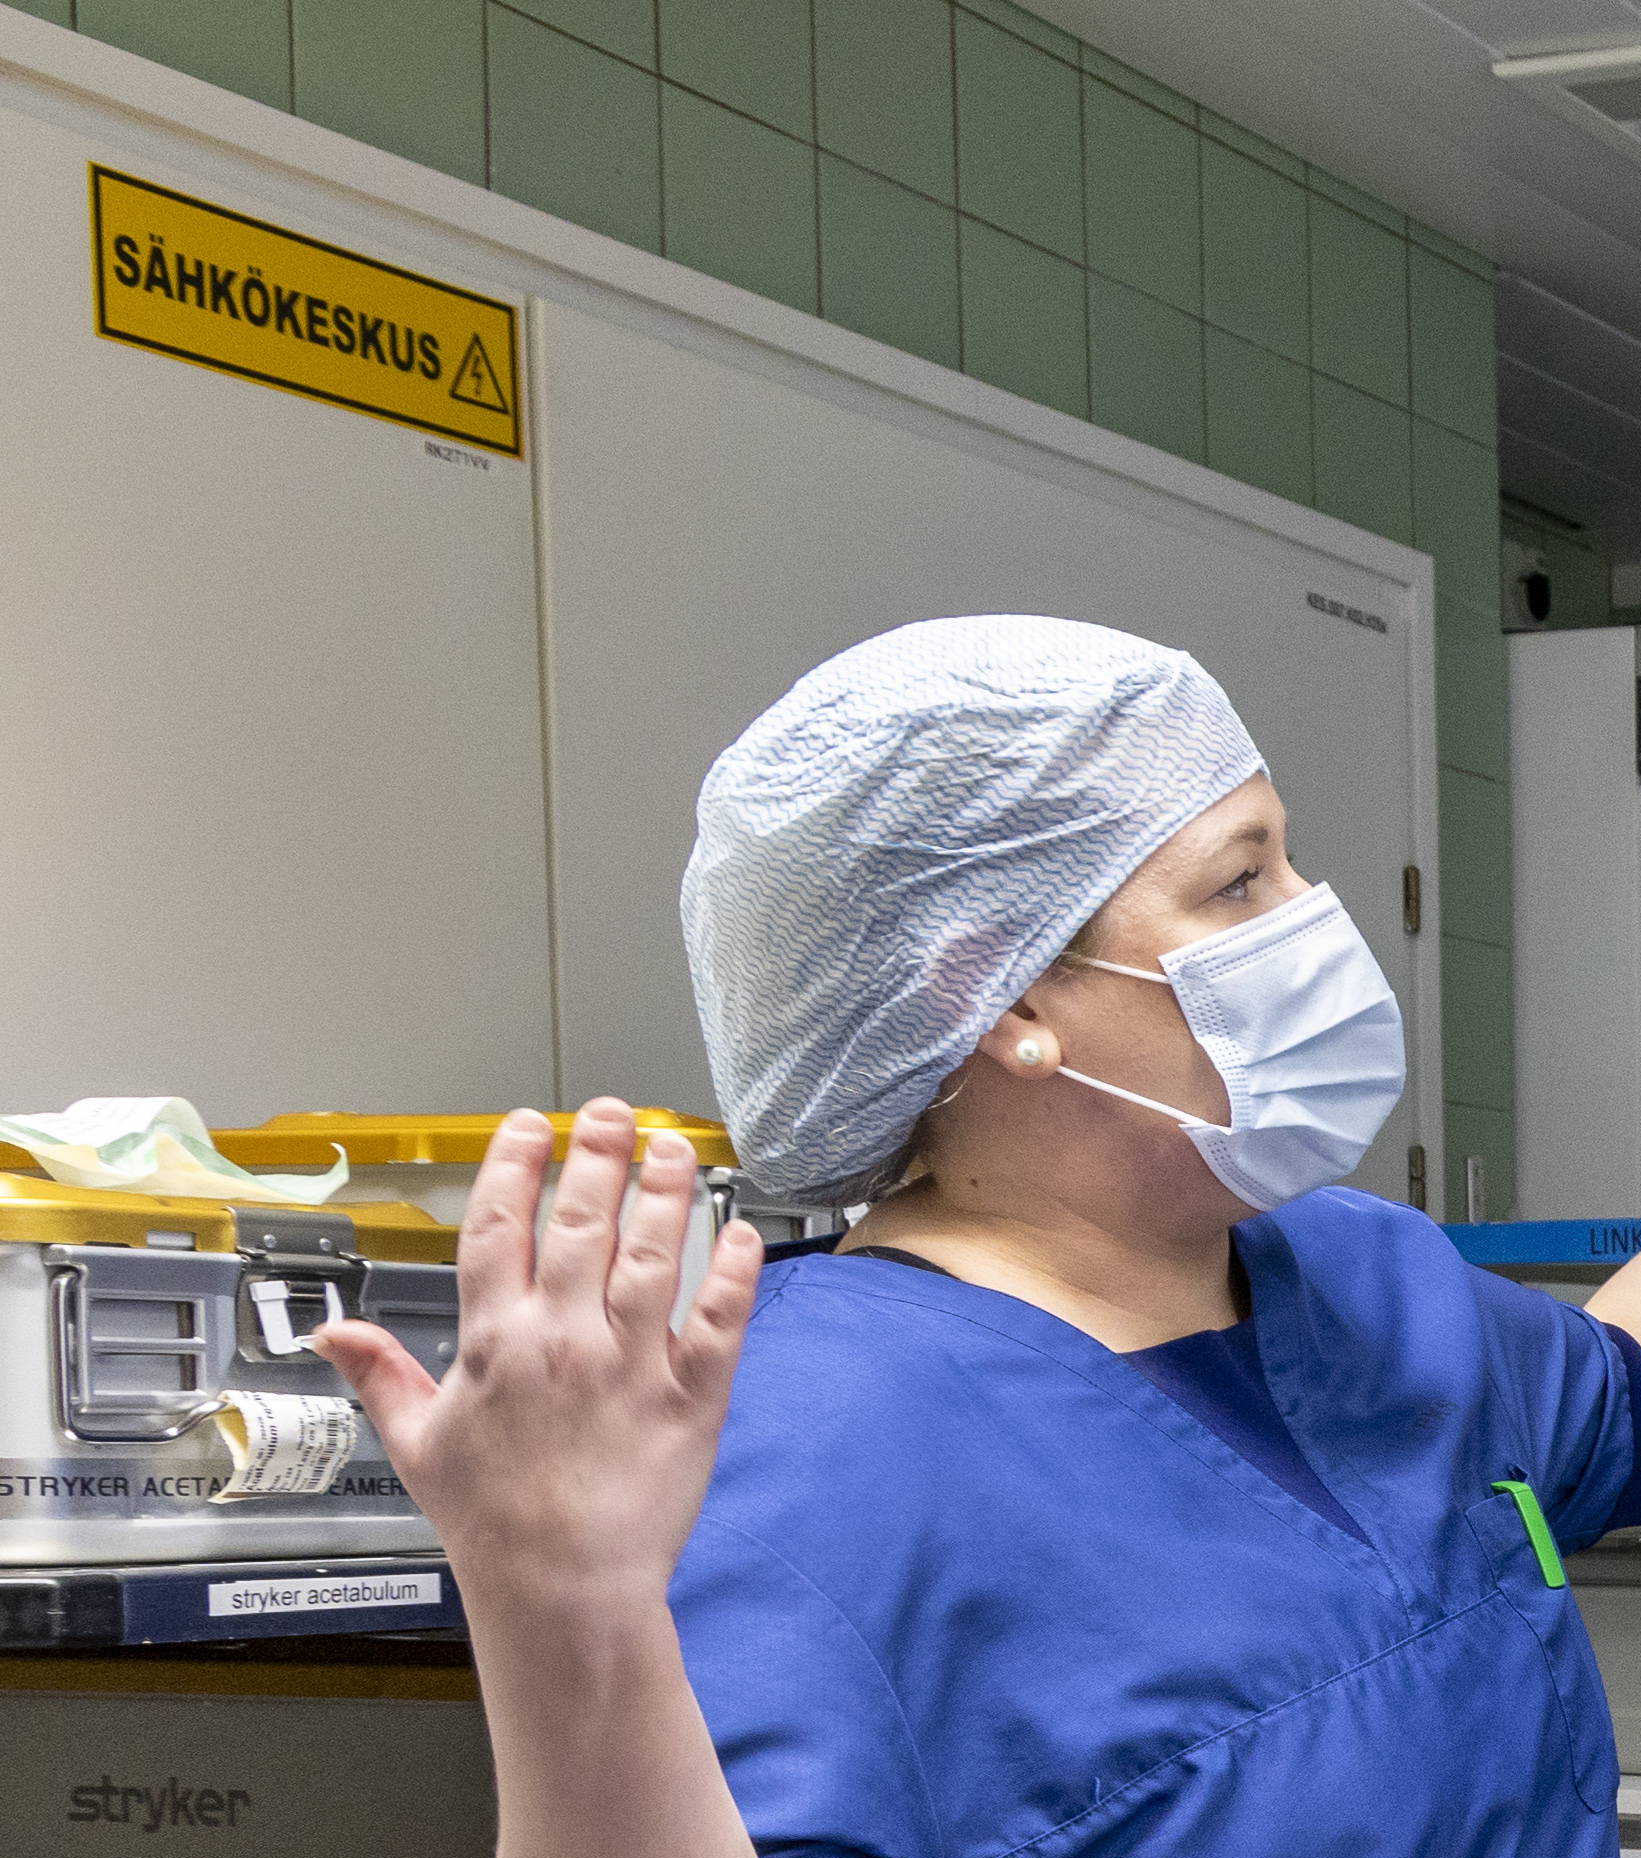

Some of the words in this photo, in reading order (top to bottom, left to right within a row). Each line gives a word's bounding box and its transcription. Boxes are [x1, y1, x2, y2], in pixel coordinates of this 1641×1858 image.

[112, 233, 443, 381] SÄHKÖKESKUS
[0, 1475, 129, 1498] STRYKER
[231, 1587, 301, 1613] stryker
[308, 1581, 419, 1605] acetabulum
[67, 1773, 252, 1833] stryker
